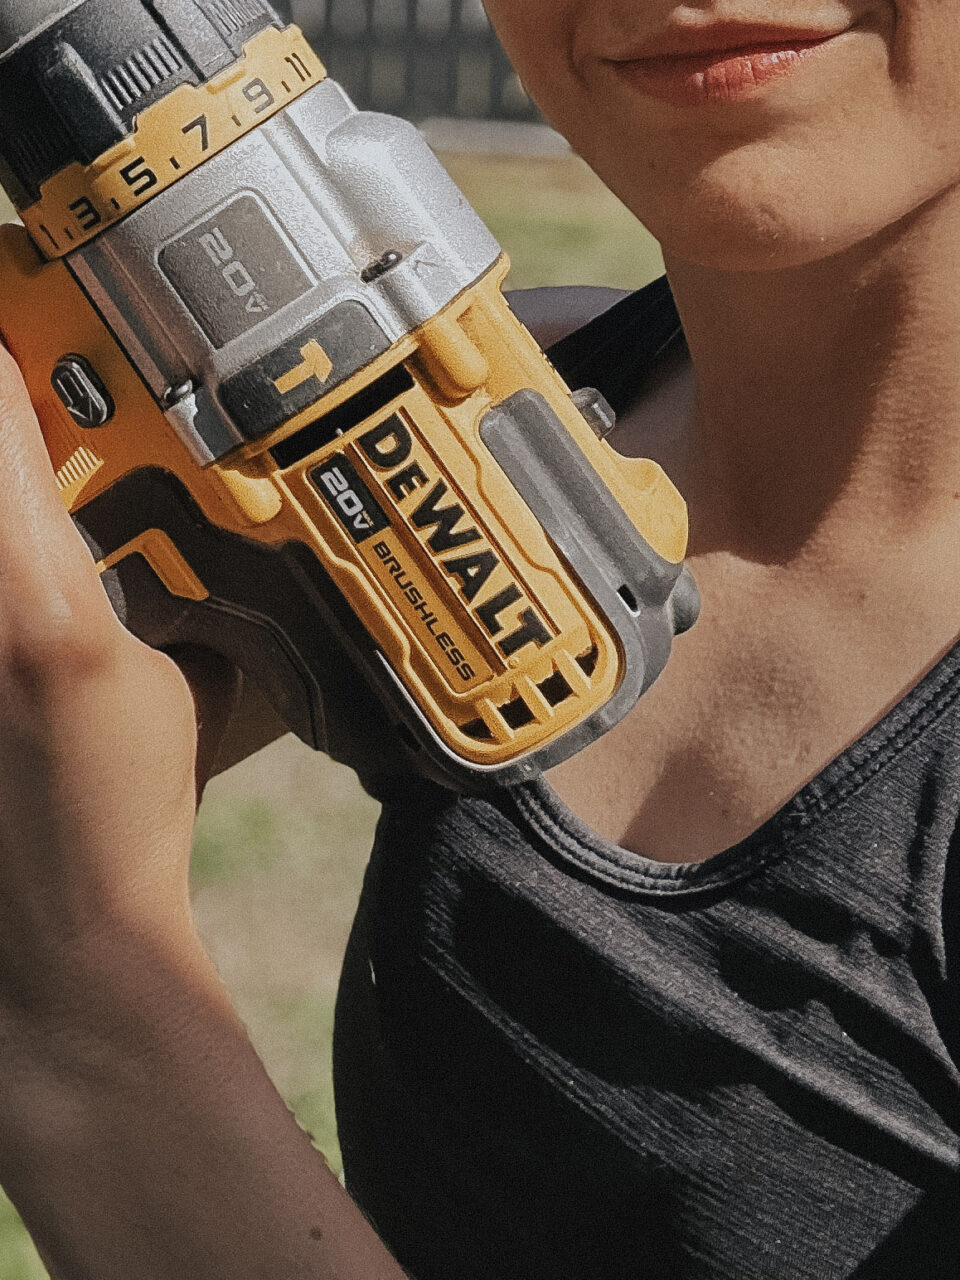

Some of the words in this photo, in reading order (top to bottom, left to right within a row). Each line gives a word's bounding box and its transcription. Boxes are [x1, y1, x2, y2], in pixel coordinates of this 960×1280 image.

[69, 196, 101, 230] 3
[120, 157, 157, 196] 5
[182, 114, 208, 151] 7
[242, 77, 274, 113] 9
[285, 53, 312, 82] 11
[354, 411, 554, 659] DEWALT
[373, 540, 475, 682] BRUSHLESS
